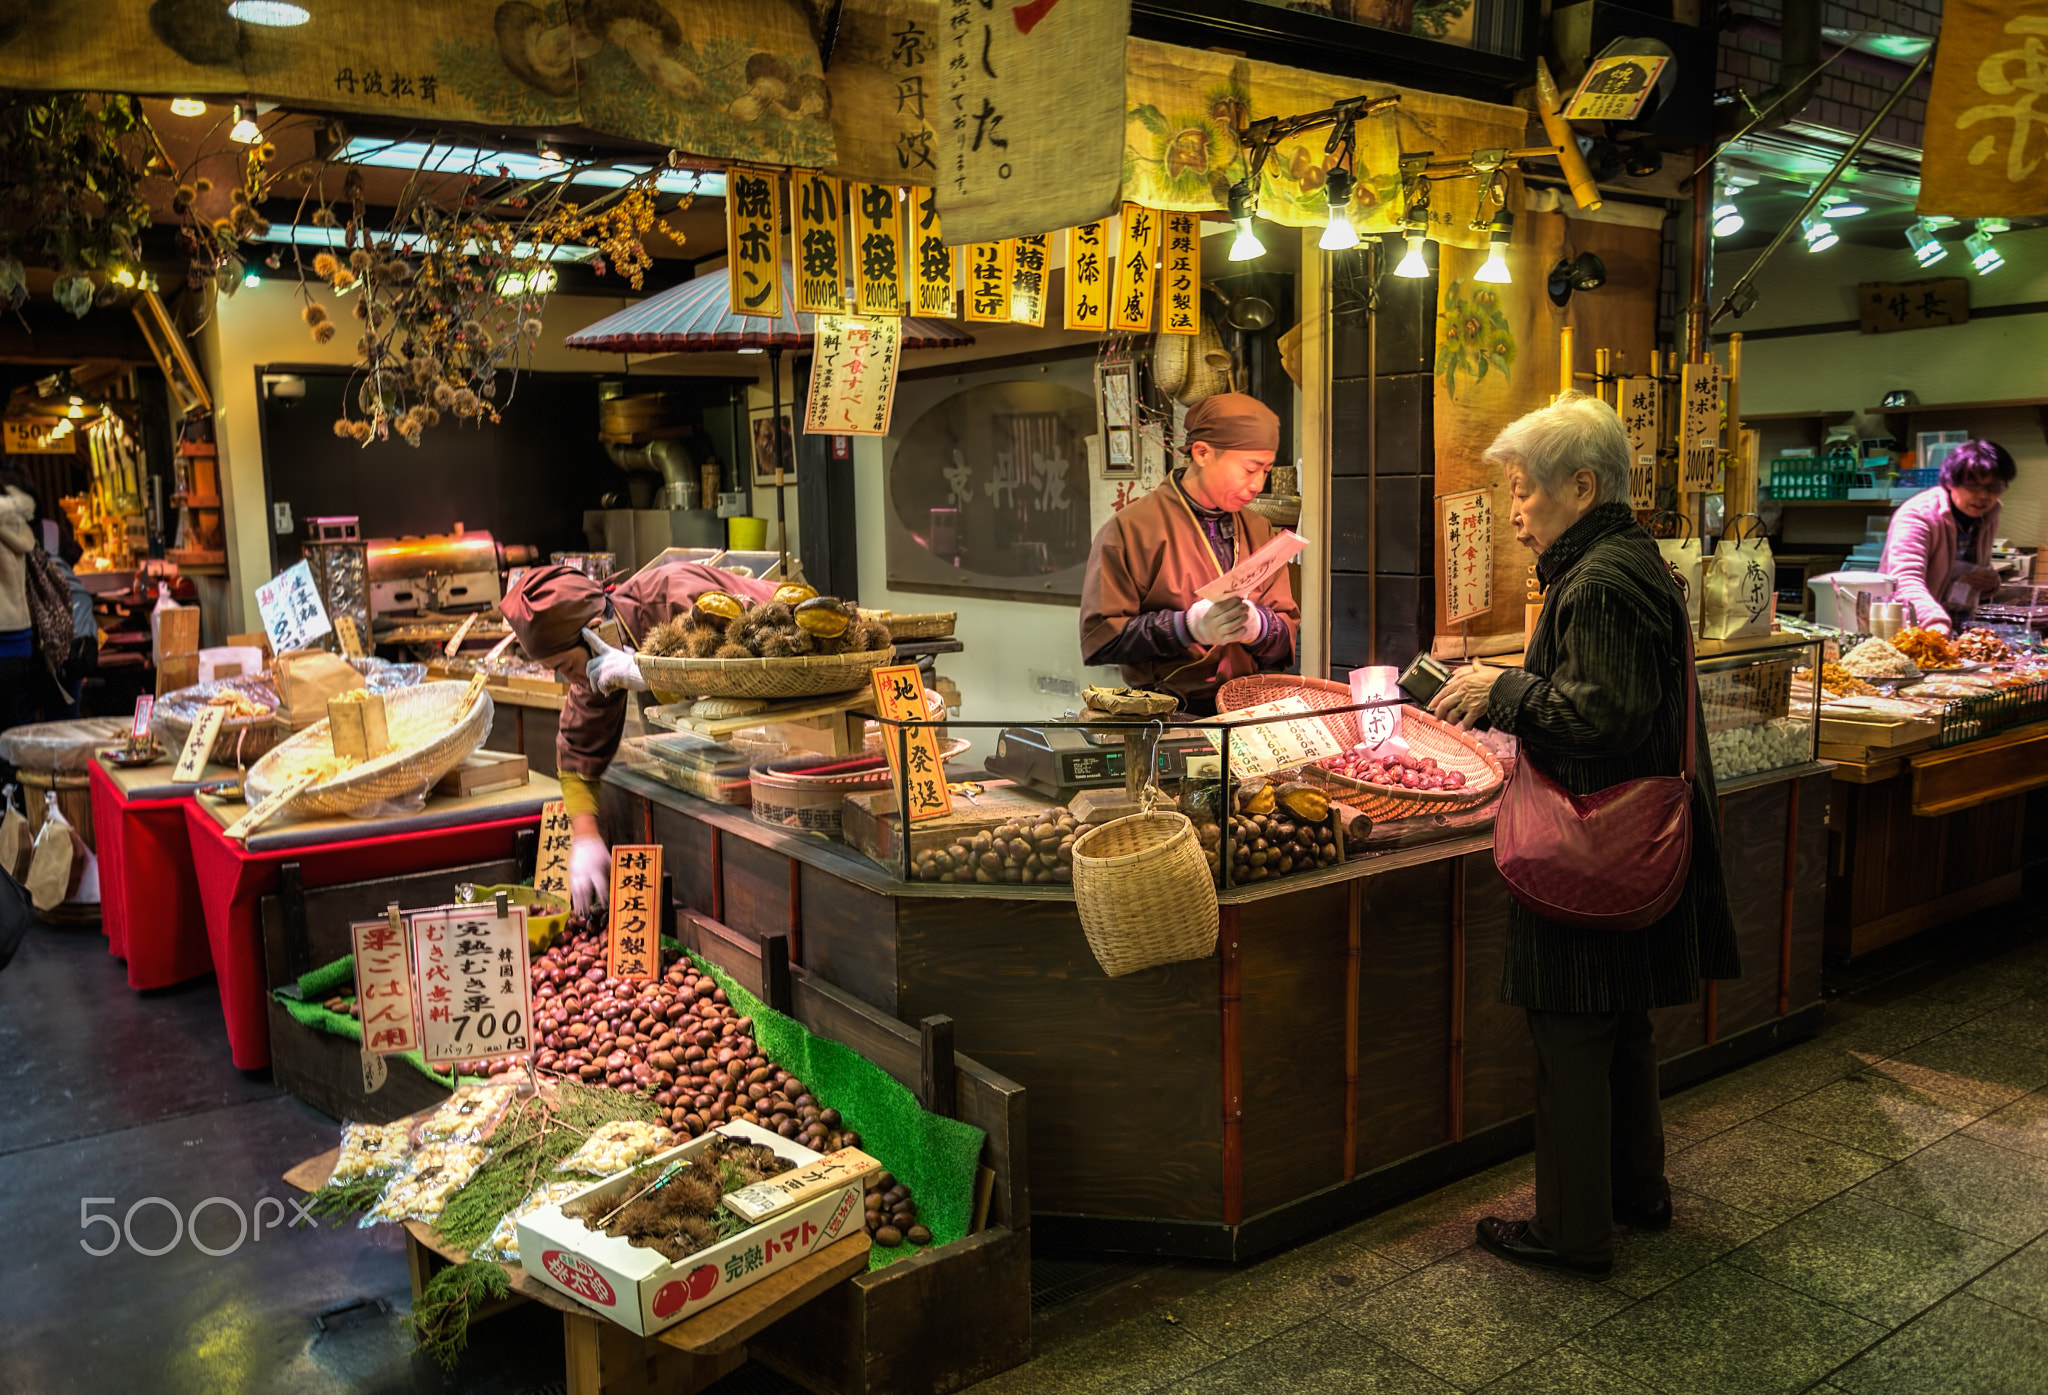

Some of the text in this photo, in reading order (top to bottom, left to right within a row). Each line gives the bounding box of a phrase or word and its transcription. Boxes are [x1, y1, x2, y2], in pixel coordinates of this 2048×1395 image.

[334, 67, 439, 104] 丹波松茸
[891, 20, 937, 169] 京丹波
[971, 0, 1012, 179] した。
[735, 175, 772, 307] 焼ポン
[802, 176, 838, 278] 小袋
[861, 184, 897, 282] 中袋
[804, 280, 838, 307] 1000円
[865, 282, 898, 309] 2000円
[920, 285, 950, 310] 3000円
[973, 239, 1005, 315] り仕上げ
[1076, 222, 1101, 321] 無添加
[1125, 213, 1151, 322] 新食感
[1169, 216, 1195, 329] 特殊圧力製法
[1632, 392, 1648, 450] 焼ポン
[1694, 377, 1711, 435] 焼ポン
[942, 445, 1071, 513] 京丹波
[1685, 449, 1715, 484] 3000円
[1462, 501, 1479, 612] 二階で食すべし。
[1475, 494, 1485, 542] 焼ポン
[1747, 559, 1764, 623] 焼ポン
[893, 676, 944, 808] 地方発送
[1365, 693, 1386, 752] 焼ポン
[540, 813, 573, 892] 特撰大粒
[617, 852, 653, 976] 特殊圧力製法
[362, 927, 409, 1048] 栗ごはん用
[425, 924, 454, 1024] むき代無料
[454, 921, 496, 1014] 完熟むき栗
[498, 948, 514, 995] 韓国産
[452, 1009, 527, 1051] 700円
[724, 1219, 819, 1284] 完熟トマト
